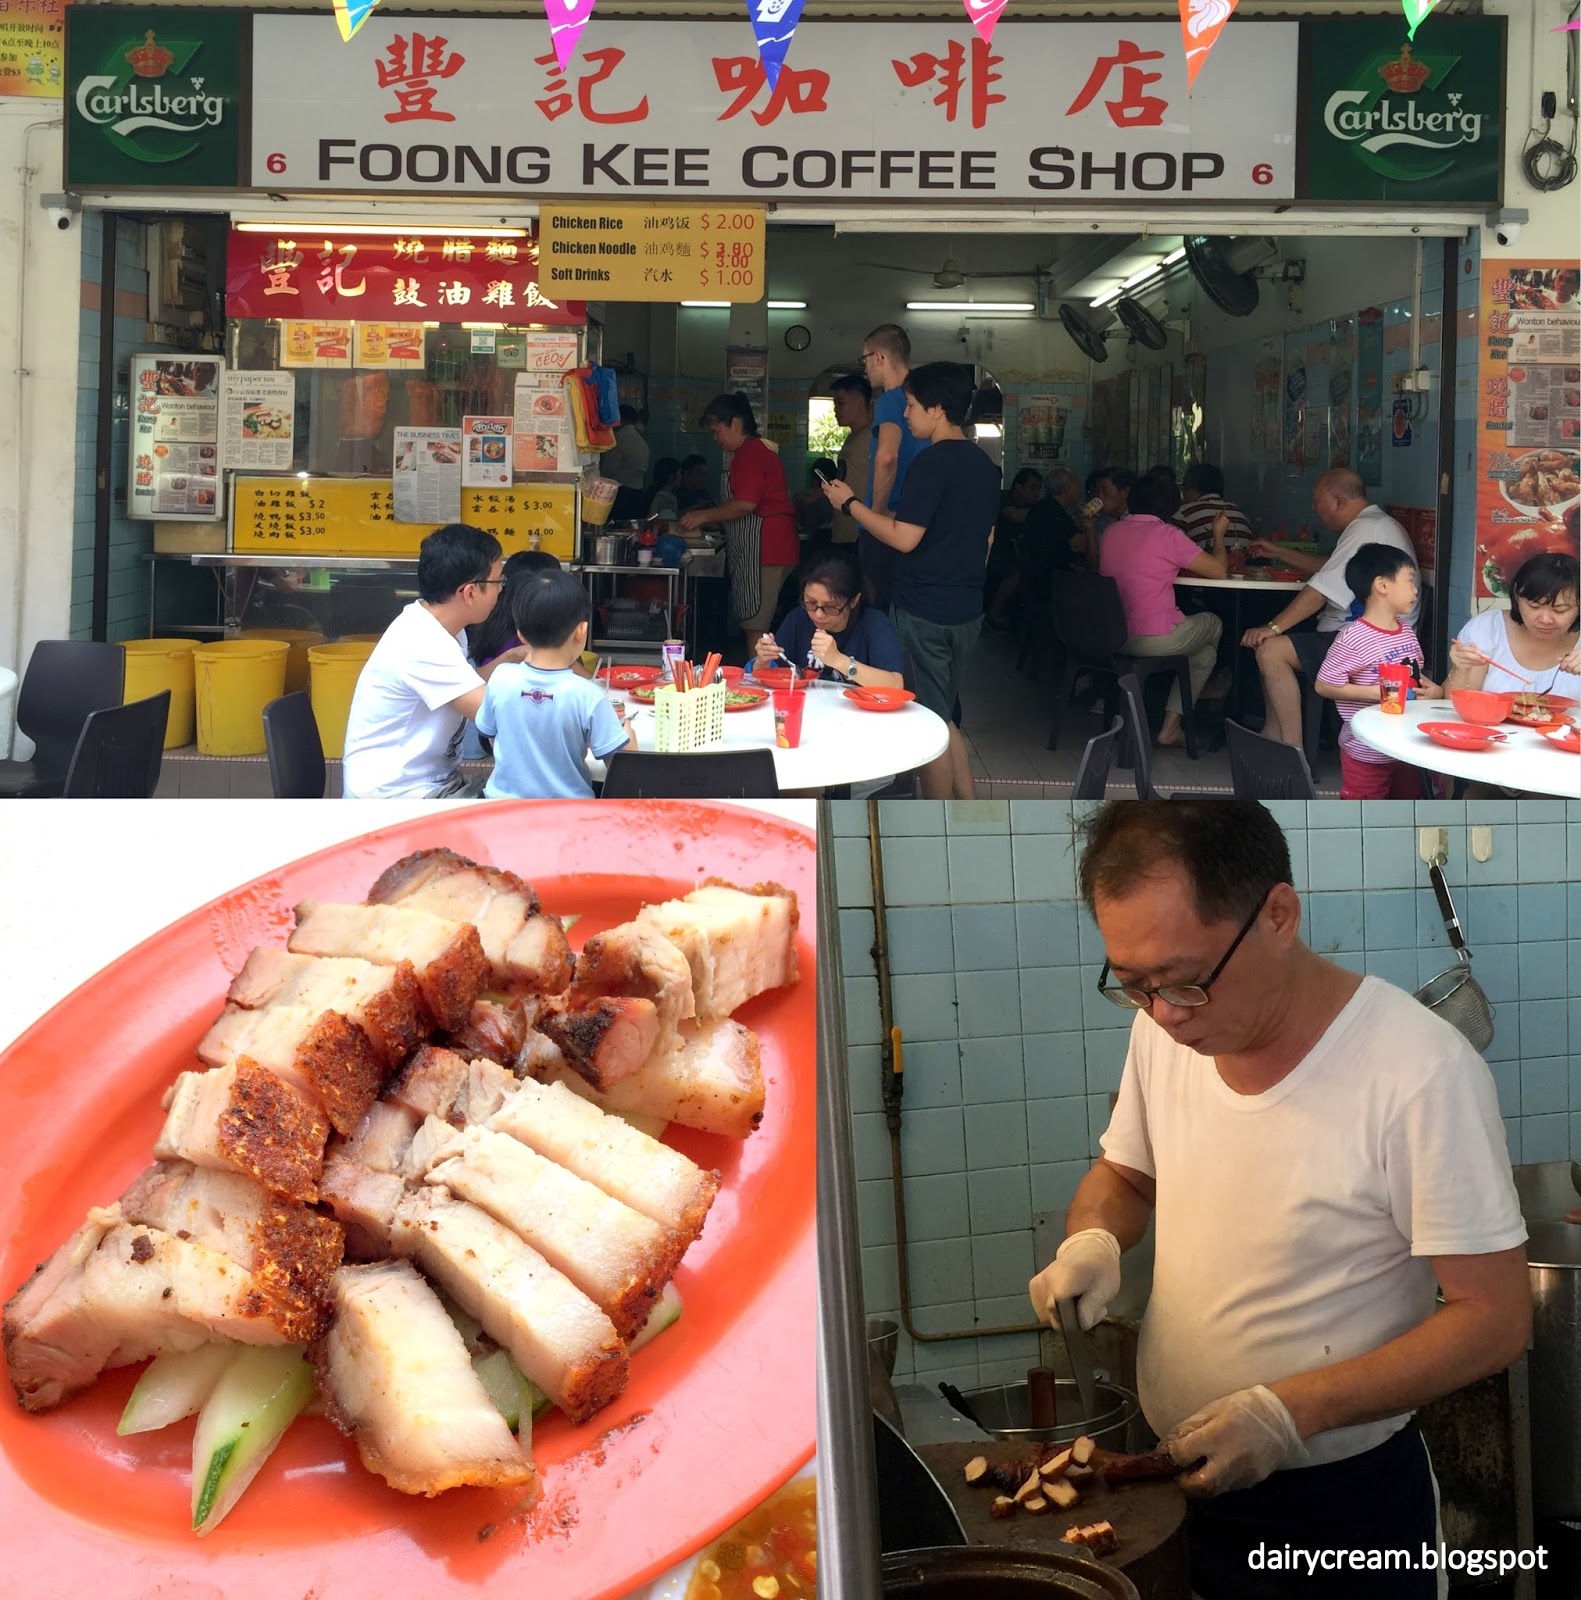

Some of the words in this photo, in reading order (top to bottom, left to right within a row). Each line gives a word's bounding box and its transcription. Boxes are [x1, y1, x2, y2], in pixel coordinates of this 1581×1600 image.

[0, 38, 60, 49] 6点至晚上10点
[76, 76, 223, 126] Carlsberg
[1324, 90, 1482, 143] Carlsberg
[266, 152, 287, 174] 6
[318, 139, 550, 184] FOONG
[583, 144, 710, 187] KEE
[742, 145, 997, 190] COFFEE
[1028, 147, 1224, 191] SHOP
[1252, 163, 1274, 185] 6
[552, 216, 597, 229] Chicken
[599, 217, 623, 229] Rice
[644, 216, 690, 230] 油鸡饭
[552, 241, 597, 255] Chicken
[599, 242, 637, 255] Noodle
[260, 239, 366, 297] 豐記
[551, 268, 573, 281] Soft
[575, 269, 610, 281] Drinks
[644, 268, 673, 282] 汽水
[1516, 317, 1545, 326] Wonton
[1547, 317, 1580, 326] behaviou
[161, 402, 184, 410] Wonton
[187, 403, 216, 411] behaviour
[442, 432, 460, 440] TIMES
[299, 512, 325, 521] $3.50
[299, 526, 325, 536] $3.00
